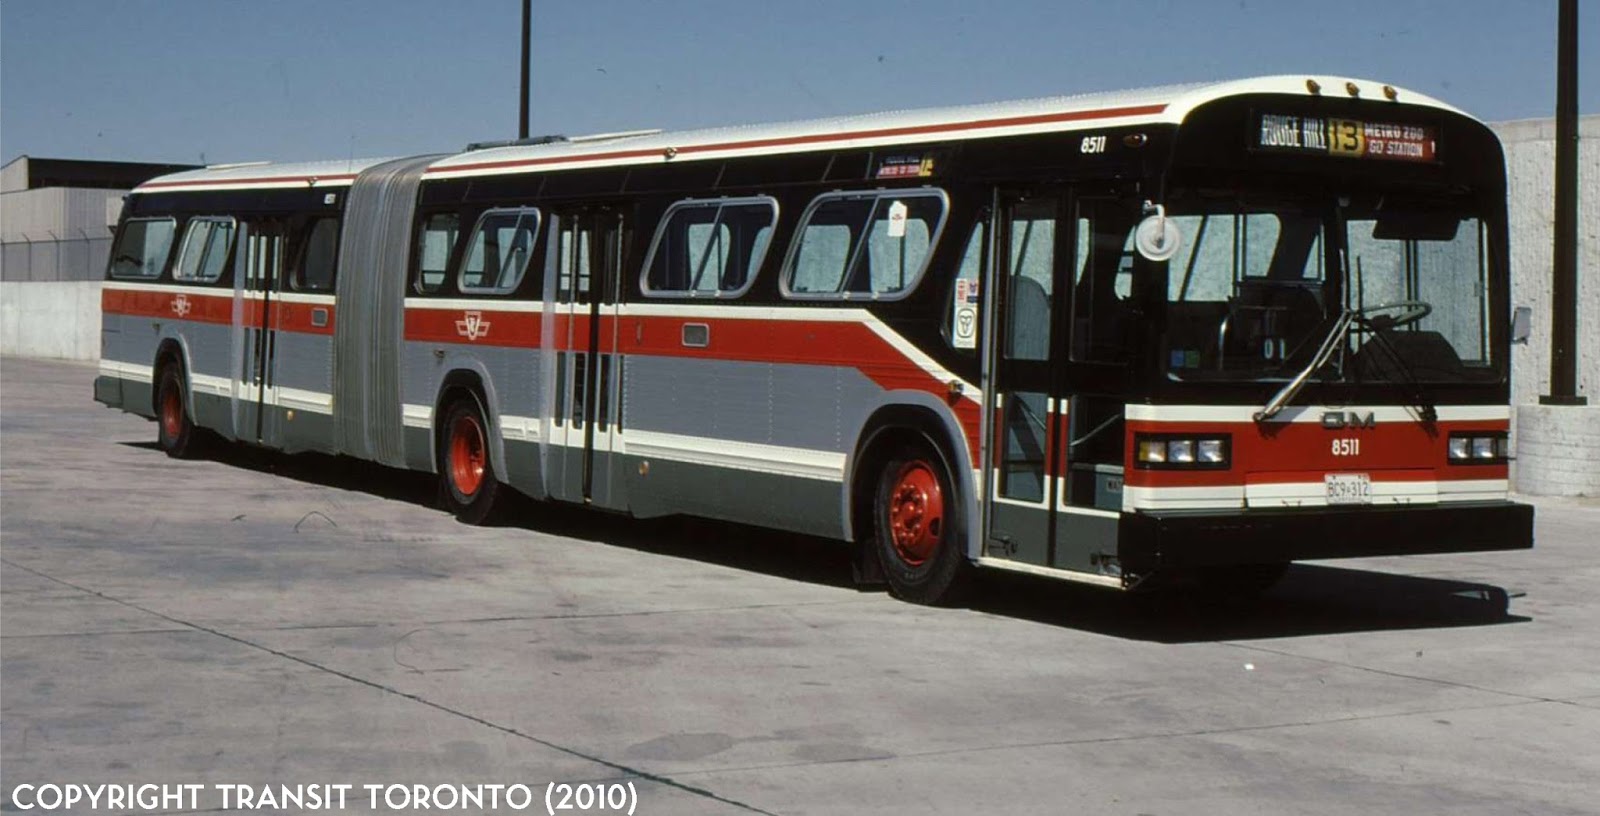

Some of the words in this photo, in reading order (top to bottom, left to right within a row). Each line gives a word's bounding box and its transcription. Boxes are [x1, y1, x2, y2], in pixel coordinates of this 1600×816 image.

[1261, 114, 1300, 147] ROUGE
[1303, 117, 1326, 149] HILL
[1330, 120, 1358, 152] 13
[1364, 122, 1401, 139] METRO
[1080, 135, 1107, 154] 8511
[1369, 139, 1384, 154] GO
[1387, 141, 1424, 158] STATION
[1331, 438, 1360, 456] 8511
